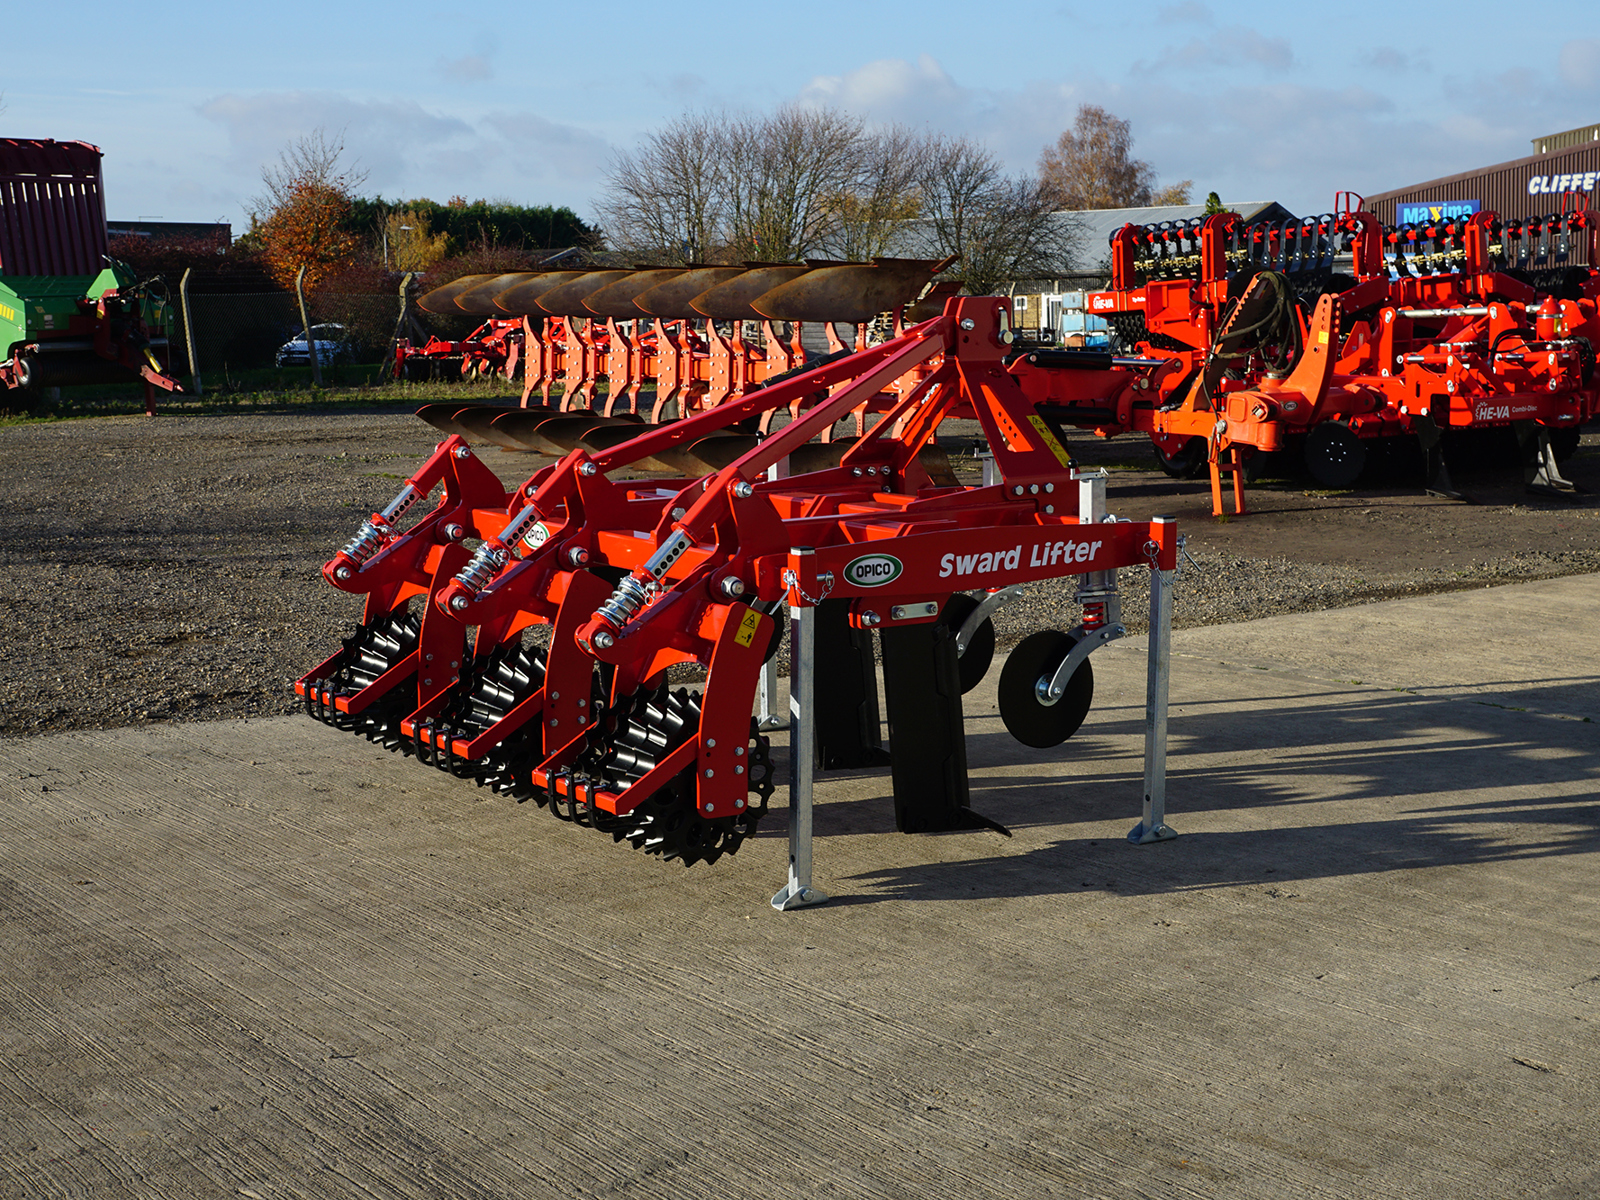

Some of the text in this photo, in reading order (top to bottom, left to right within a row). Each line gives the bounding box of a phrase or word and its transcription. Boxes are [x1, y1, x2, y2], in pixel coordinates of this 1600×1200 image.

[1403, 203, 1473, 224] Maxima
[1479, 406, 1510, 420] HE-VA
[938, 539, 1103, 578] Sward Lifter
[855, 562, 891, 579] OPICO
